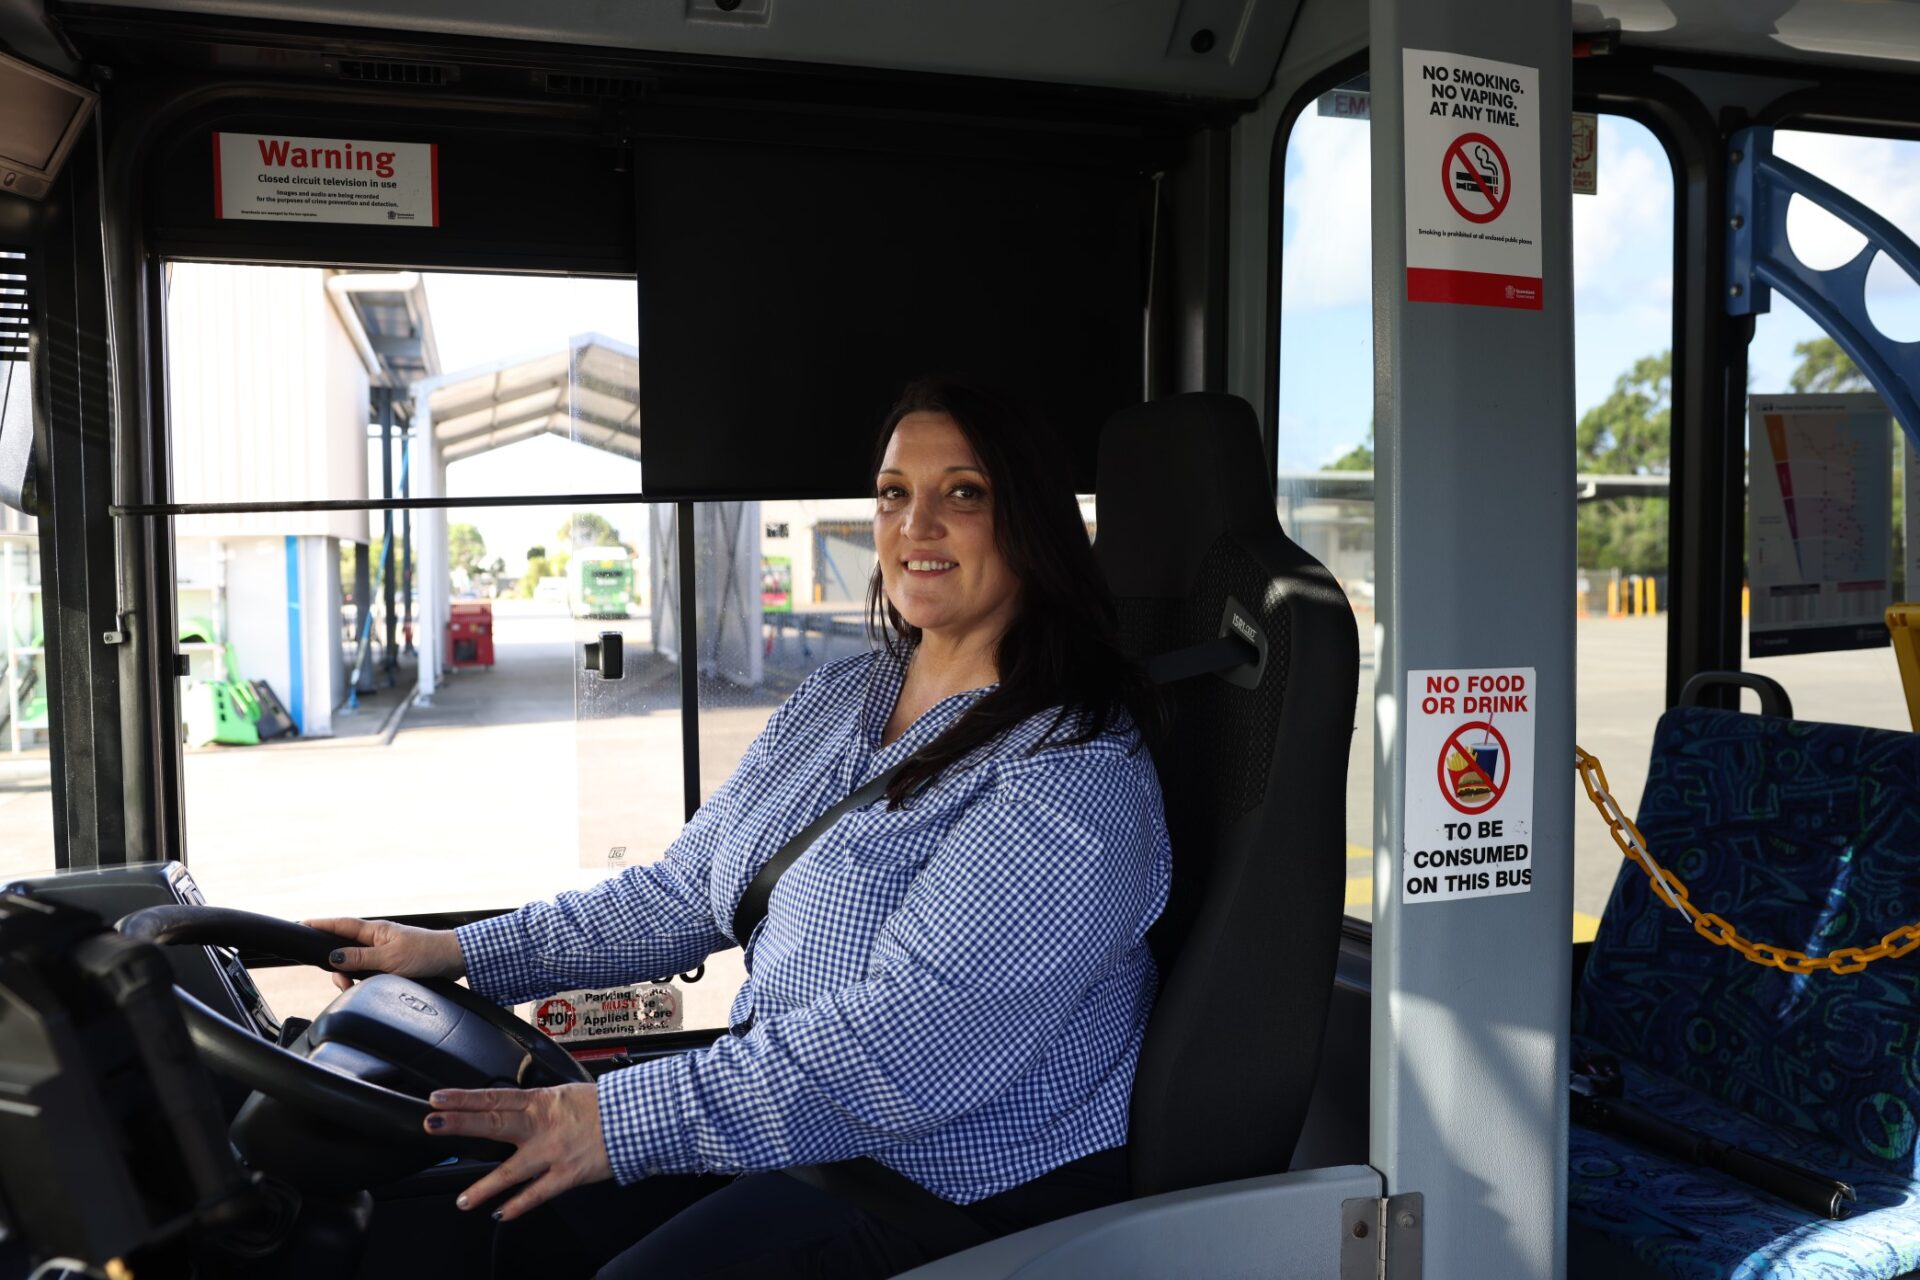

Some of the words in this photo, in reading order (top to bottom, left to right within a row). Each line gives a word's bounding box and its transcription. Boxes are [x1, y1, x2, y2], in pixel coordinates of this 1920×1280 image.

[1423, 65, 1448, 81] NO
[1453, 68, 1524, 94] SMOKING.
[1432, 84, 1457, 100] NO
[1461, 87, 1517, 110] VAPING.
[1430, 101, 1448, 116] AT
[1452, 103, 1482, 121] ANY
[1485, 108, 1519, 127] TIME.
[258, 139, 396, 178] Warning
[258, 174, 290, 184] Closed
[292, 175, 321, 185] circuit
[323, 176, 368, 188] television
[370, 178, 379, 188] in
[381, 180, 397, 189] use
[1418, 228, 1442, 237] Smoking
[1447, 231, 1472, 239] prohibited
[1426, 676, 1460, 694] NO
[1467, 675, 1525, 693] FOOD
[1422, 697, 1455, 714] OR
[1463, 695, 1528, 714] DRINK
[1444, 822, 1472, 841] TO
[1478, 820, 1503, 838] BE
[1413, 844, 1529, 869] CONSUMED
[1406, 876, 1438, 895] ON
[1445, 872, 1489, 892] THIS
[1496, 868, 1531, 888] BUS
[602, 998, 637, 1012] MUST
[584, 1011, 629, 1026] Applied
[588, 1024, 635, 1036] Leaving
